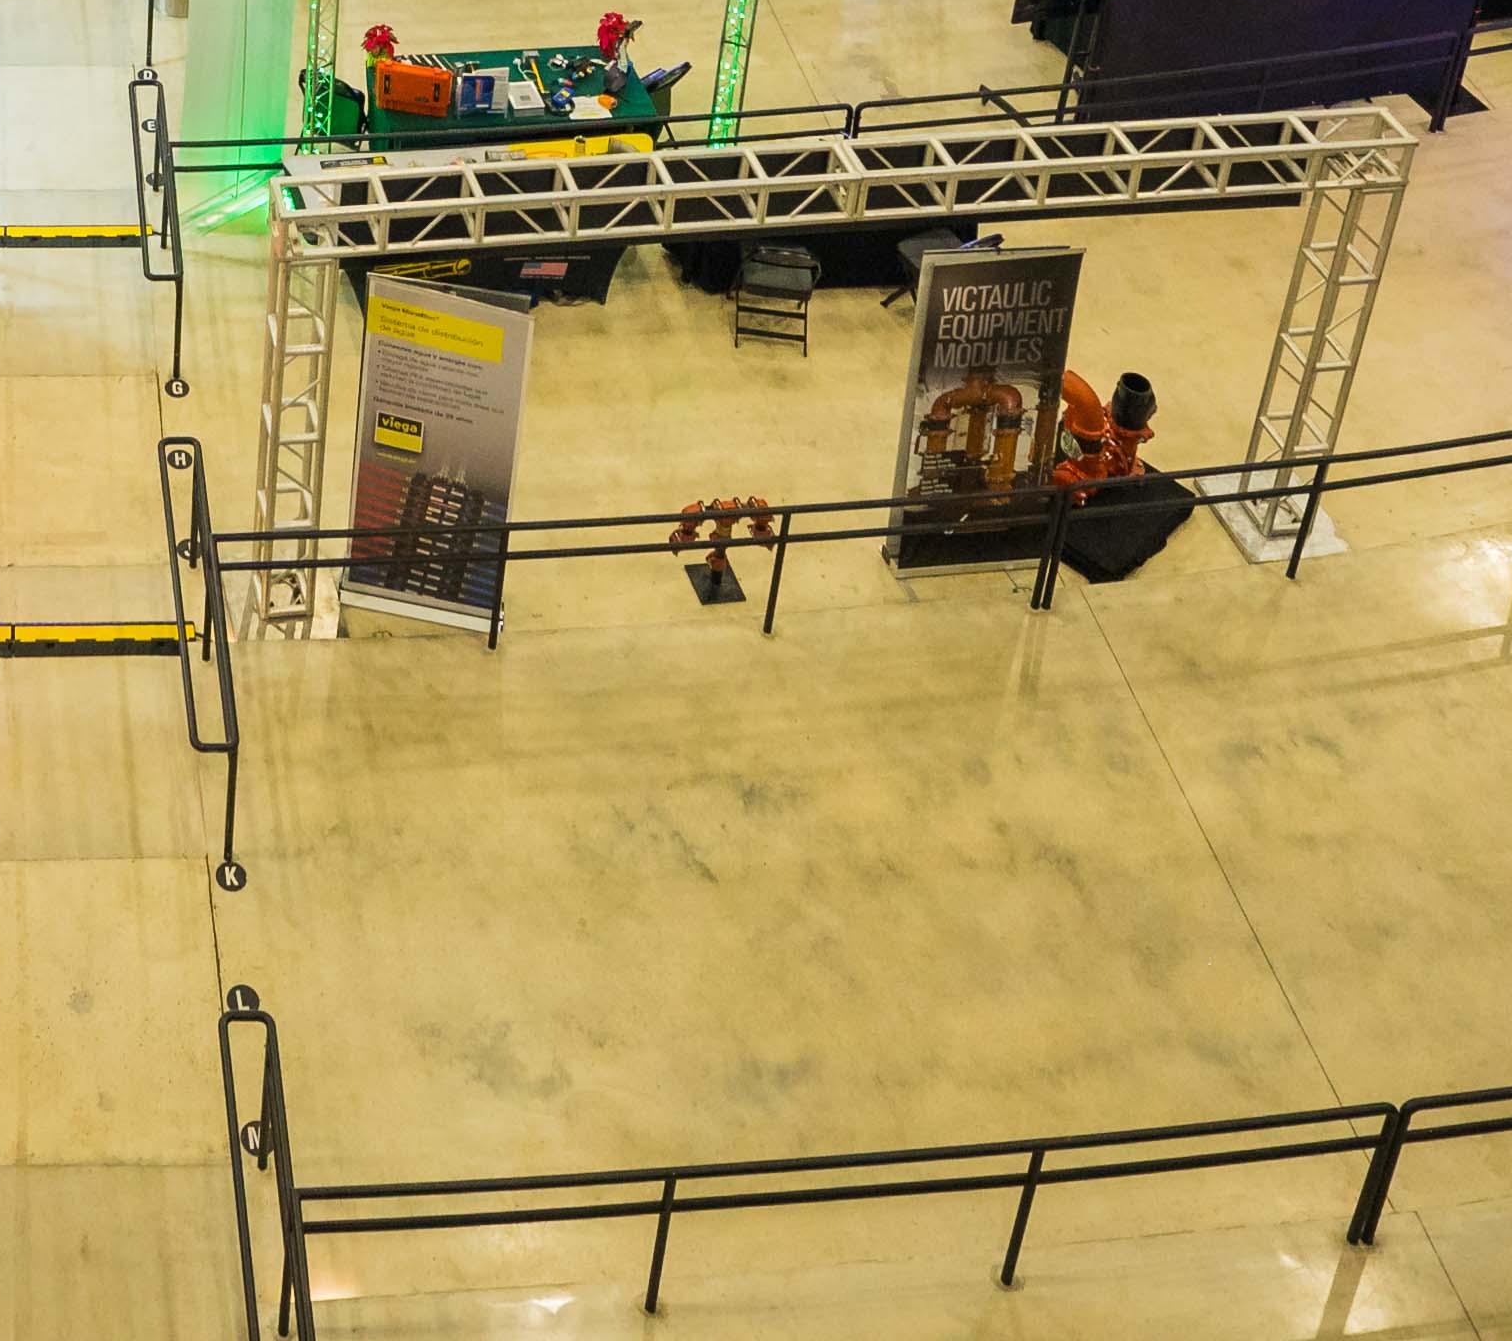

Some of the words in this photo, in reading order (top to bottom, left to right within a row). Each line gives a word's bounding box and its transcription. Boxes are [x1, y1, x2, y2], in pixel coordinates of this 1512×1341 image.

[942, 280, 1053, 313] VICTAULIC
[378, 324, 391, 333] de
[418, 324, 430, 334] de
[937, 306, 1069, 344] EQUIPMENT
[934, 336, 1044, 368] MODULES
[381, 416, 418, 434] viega
